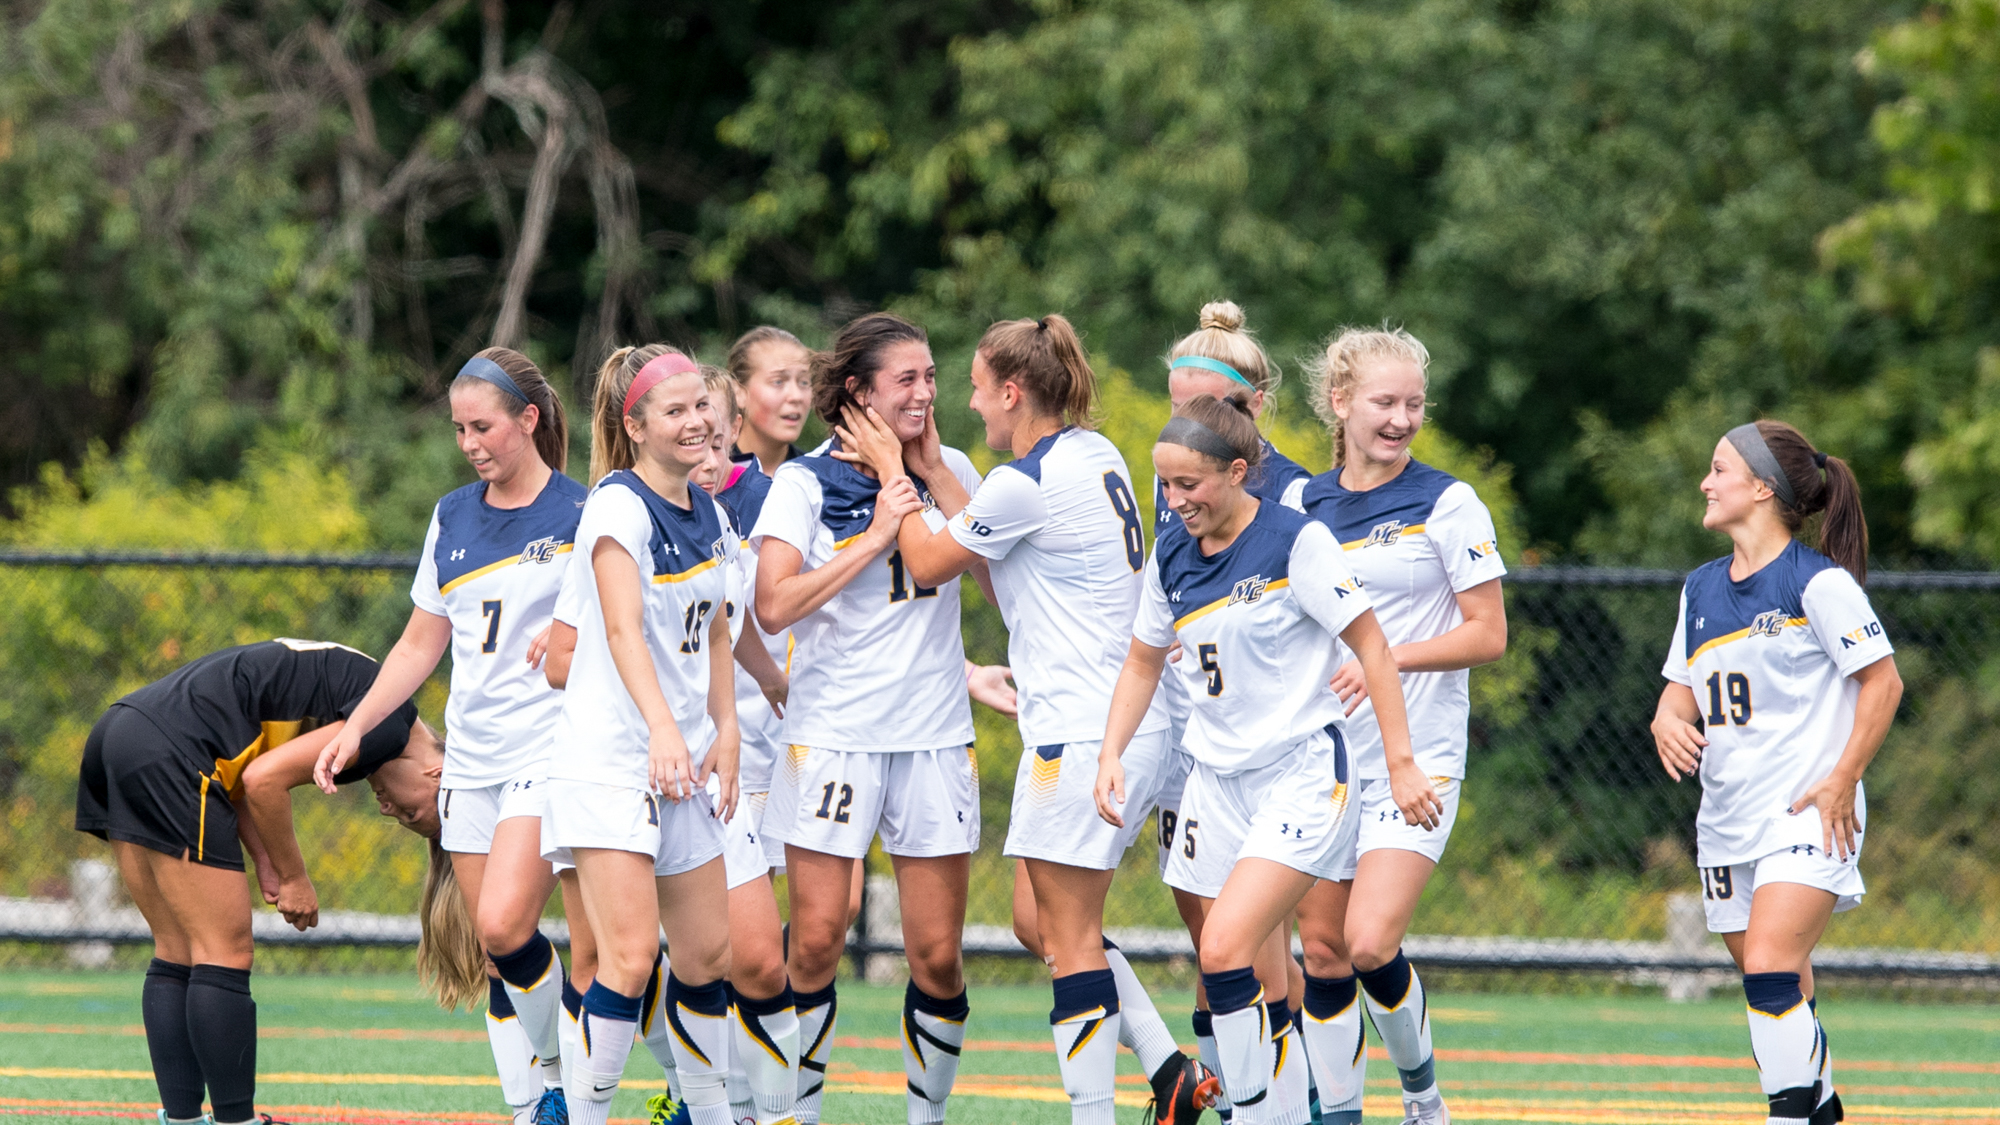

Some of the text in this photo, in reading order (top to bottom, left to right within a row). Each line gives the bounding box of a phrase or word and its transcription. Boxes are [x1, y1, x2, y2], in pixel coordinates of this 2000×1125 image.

[1103, 470, 1145, 574] 8
[1363, 520, 1409, 549] MC
[518, 536, 564, 565] MC
[1227, 574, 1271, 607] MC
[481, 600, 502, 654] 7
[1748, 609, 1792, 638] MC
[1840, 621, 1881, 649] NE10
[1198, 642, 1224, 698] 5
[1706, 671, 1753, 727] 19
[815, 780, 853, 825] 12
[1184, 817, 1198, 860] 5
